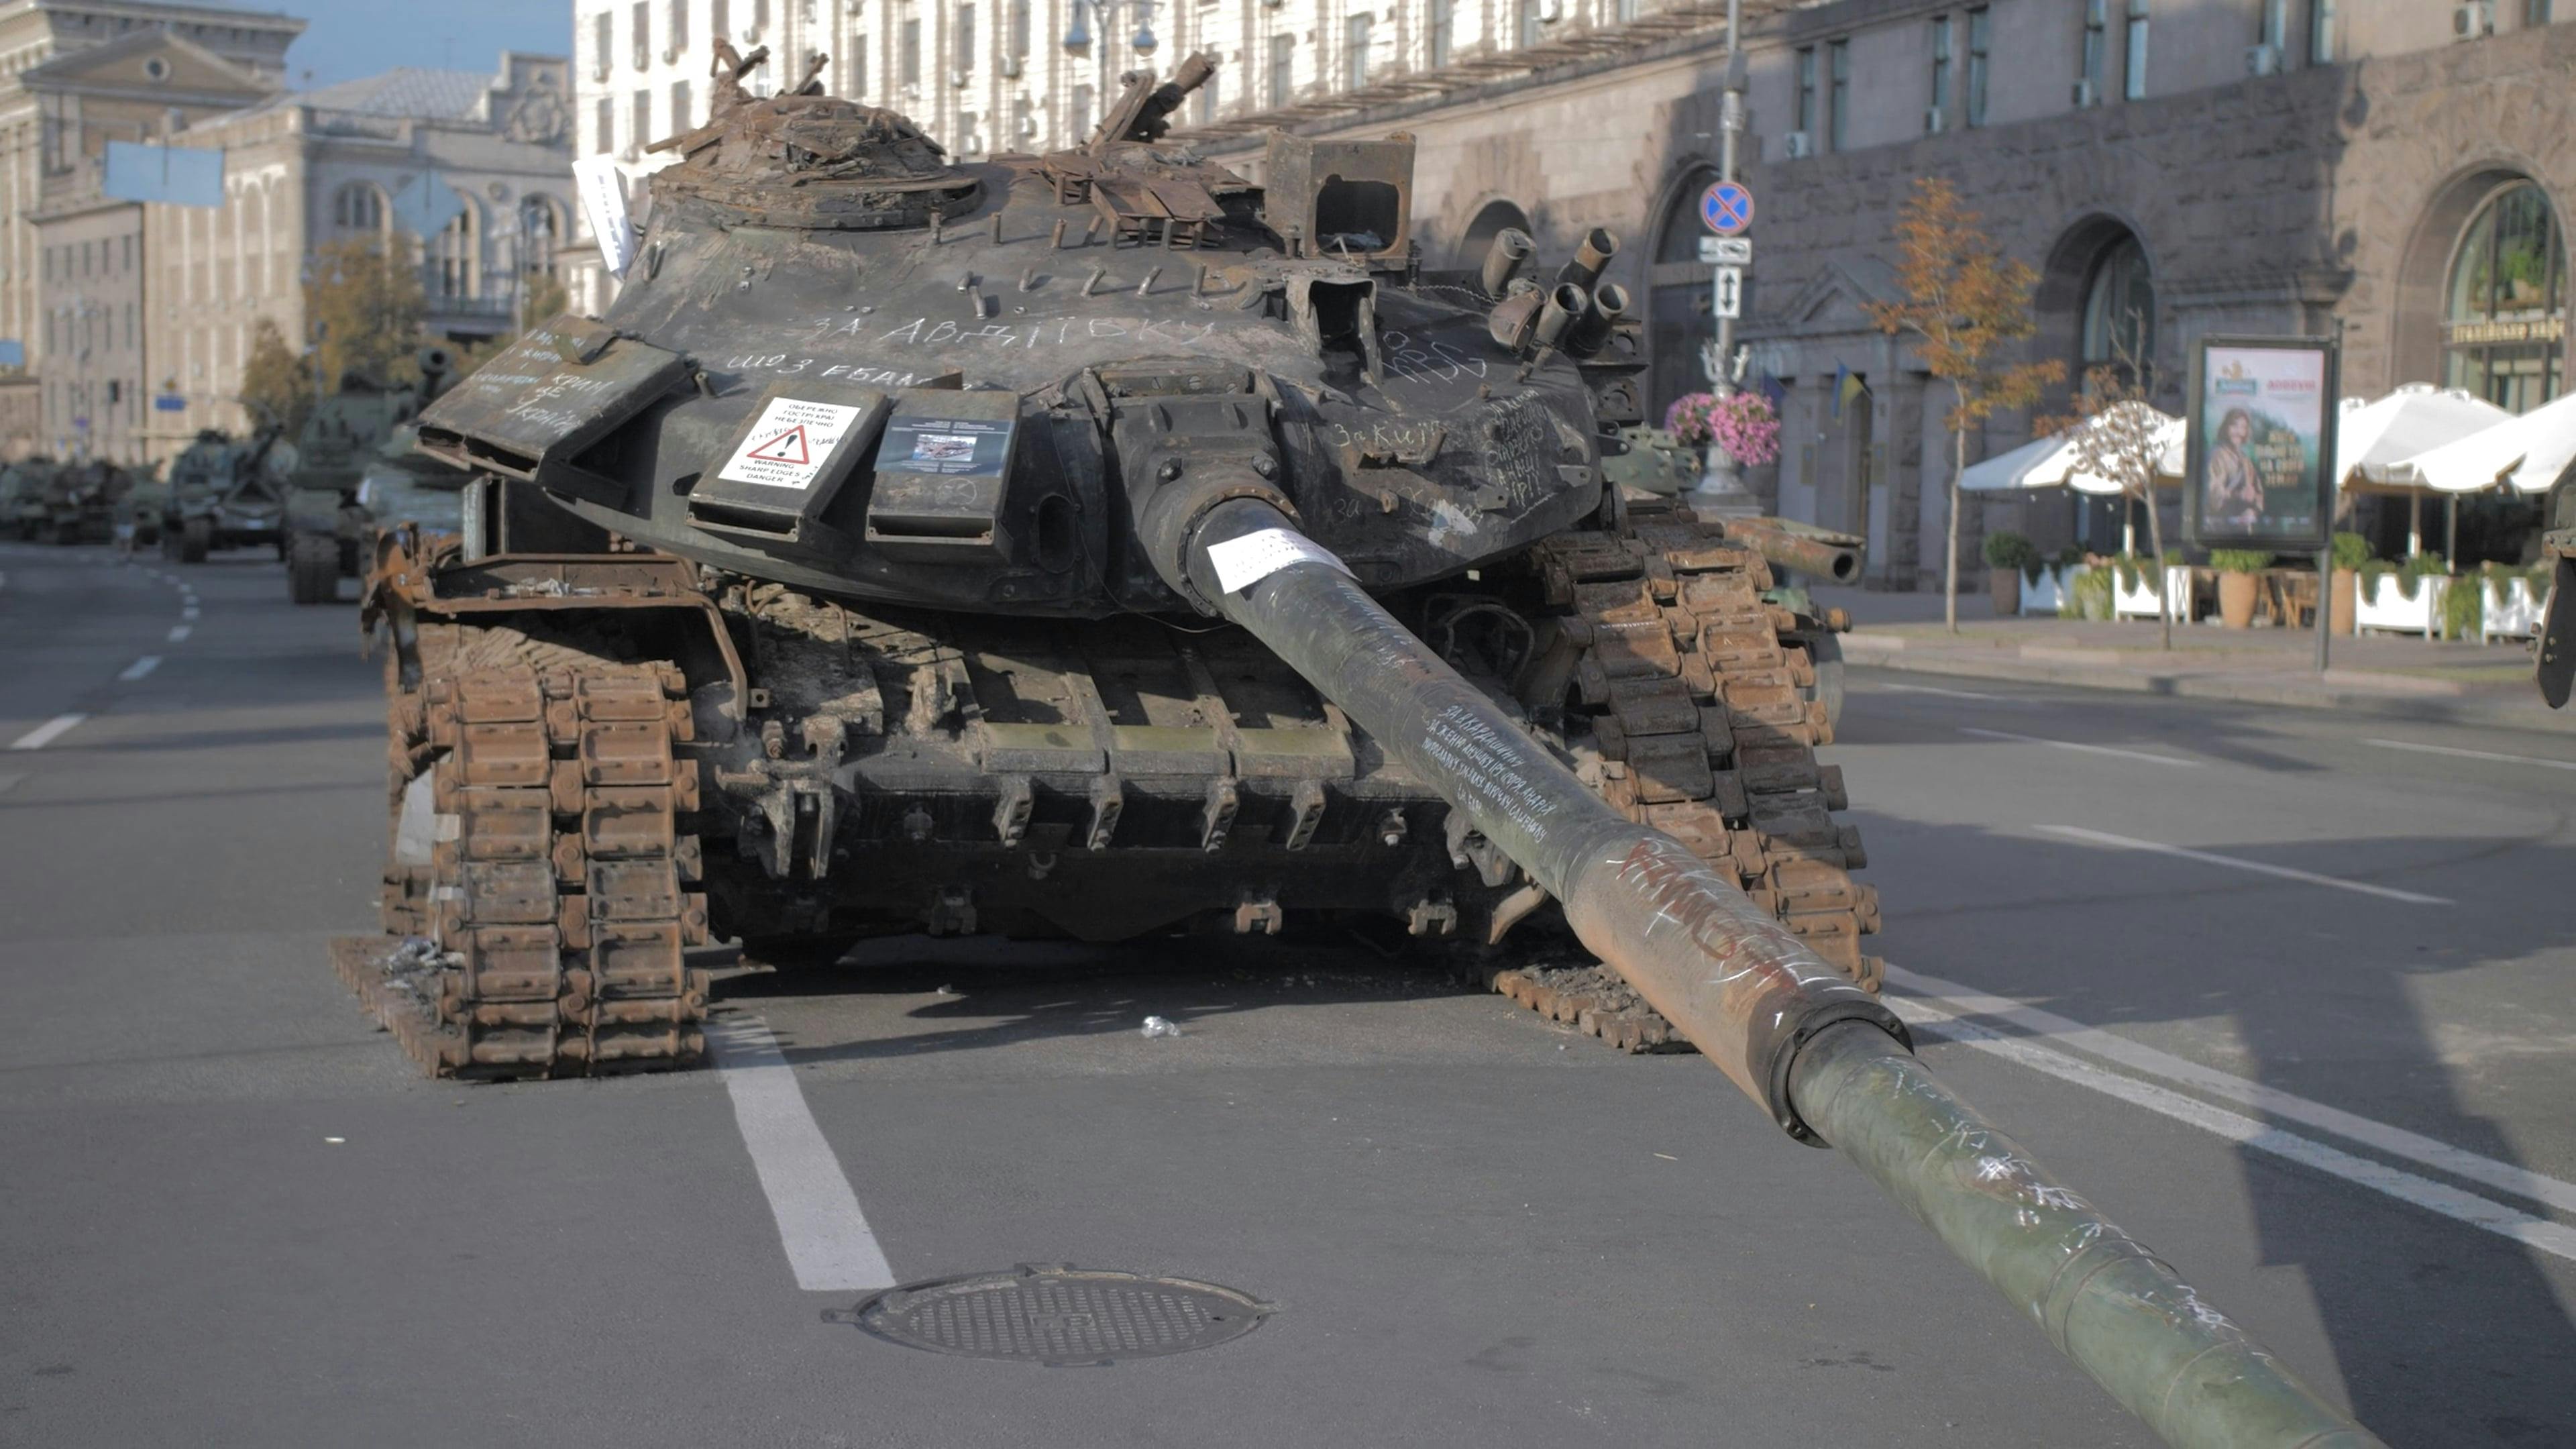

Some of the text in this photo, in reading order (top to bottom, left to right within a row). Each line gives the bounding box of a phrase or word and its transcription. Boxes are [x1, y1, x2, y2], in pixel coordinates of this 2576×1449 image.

[804, 317, 861, 341] ЗА
[552, 373, 614, 396] КРИМ
[788, 404, 838, 414] ОБЕРЕЖНО
[783, 410, 814, 419] ГОСТРІ
[775, 417, 834, 427] НЕБЕЗПЕЧНО
[739, 465, 769, 474] SHARP
[754, 460, 795, 469] WARNING
[746, 474, 784, 482] DANGER
[1438, 705, 1462, 719] ЗА
